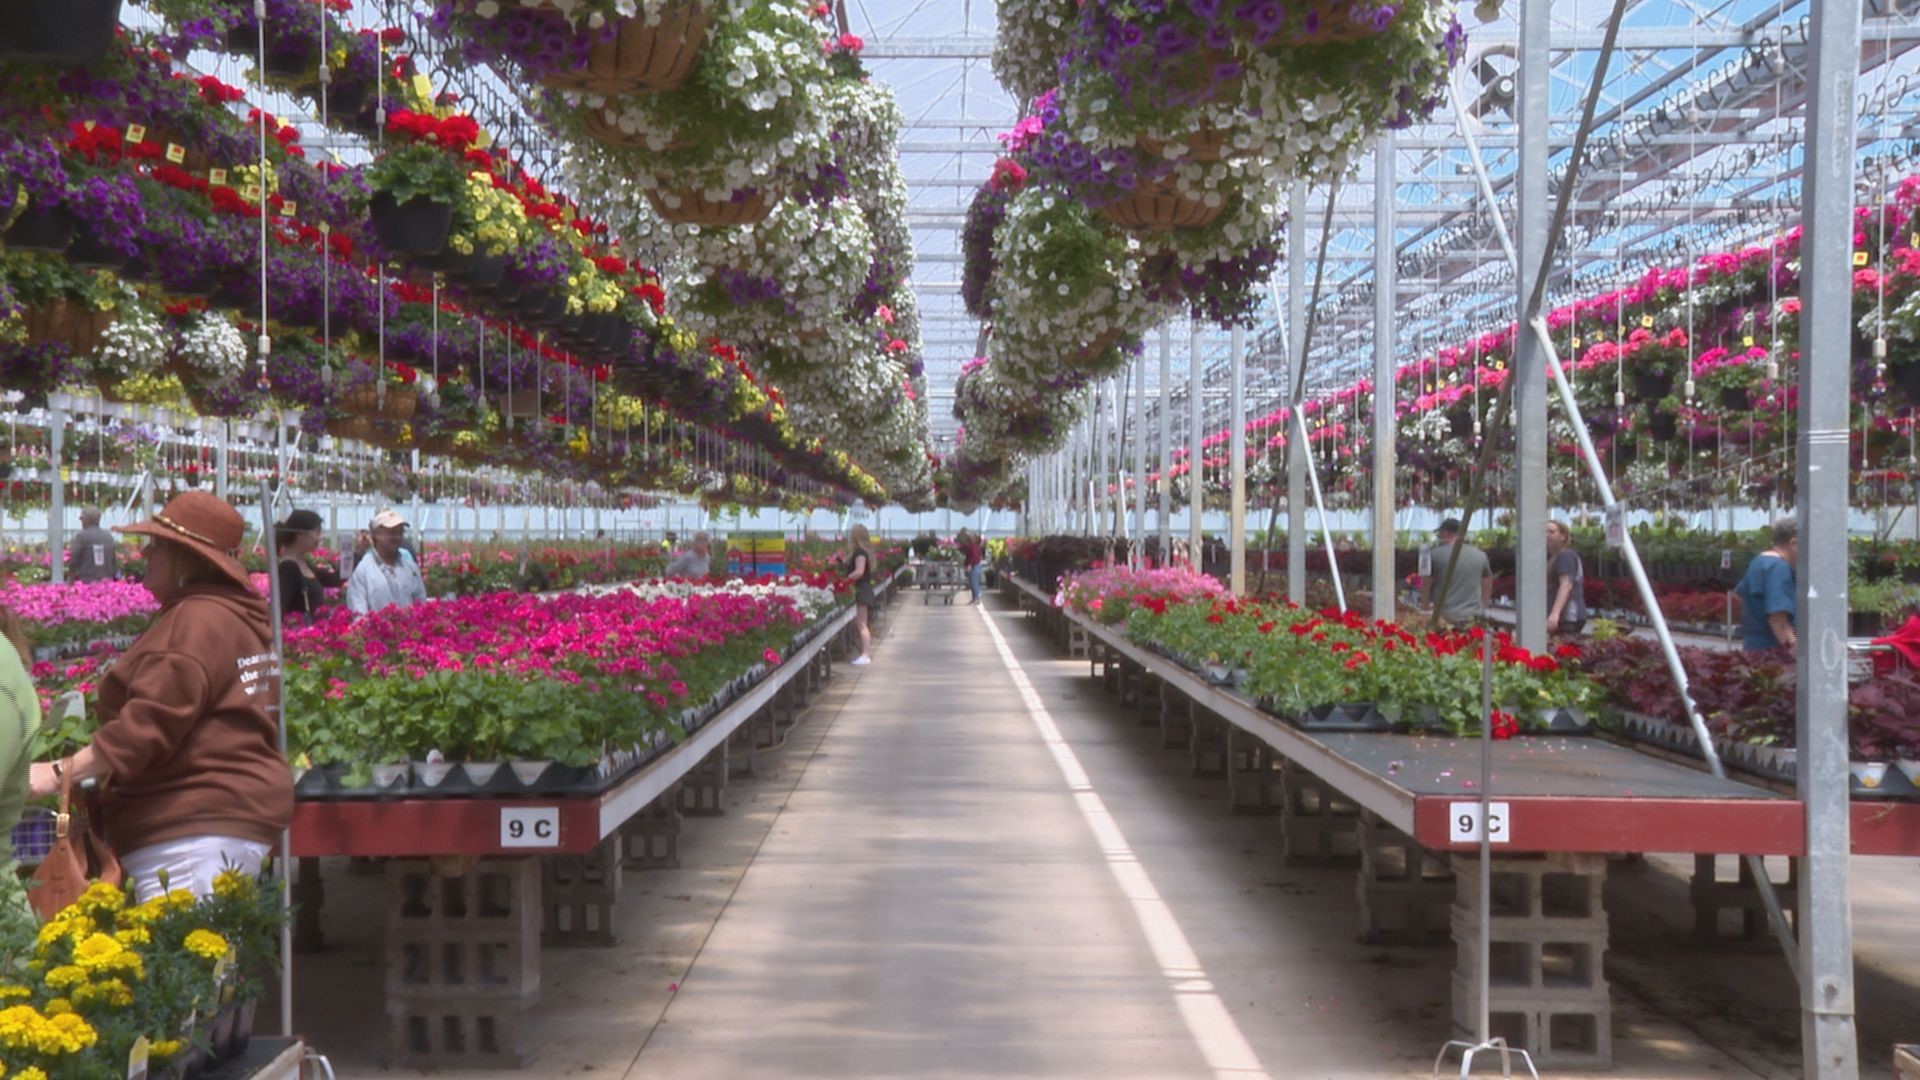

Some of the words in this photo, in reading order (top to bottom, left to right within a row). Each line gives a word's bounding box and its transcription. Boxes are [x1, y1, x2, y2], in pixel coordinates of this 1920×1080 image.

[237, 655, 259, 669] Dear
[240, 671, 258, 683] the
[509, 819, 524, 838] 9
[534, 819, 552, 838] C
[1458, 815, 1473, 833] 9
[1488, 815, 1501, 832] C
